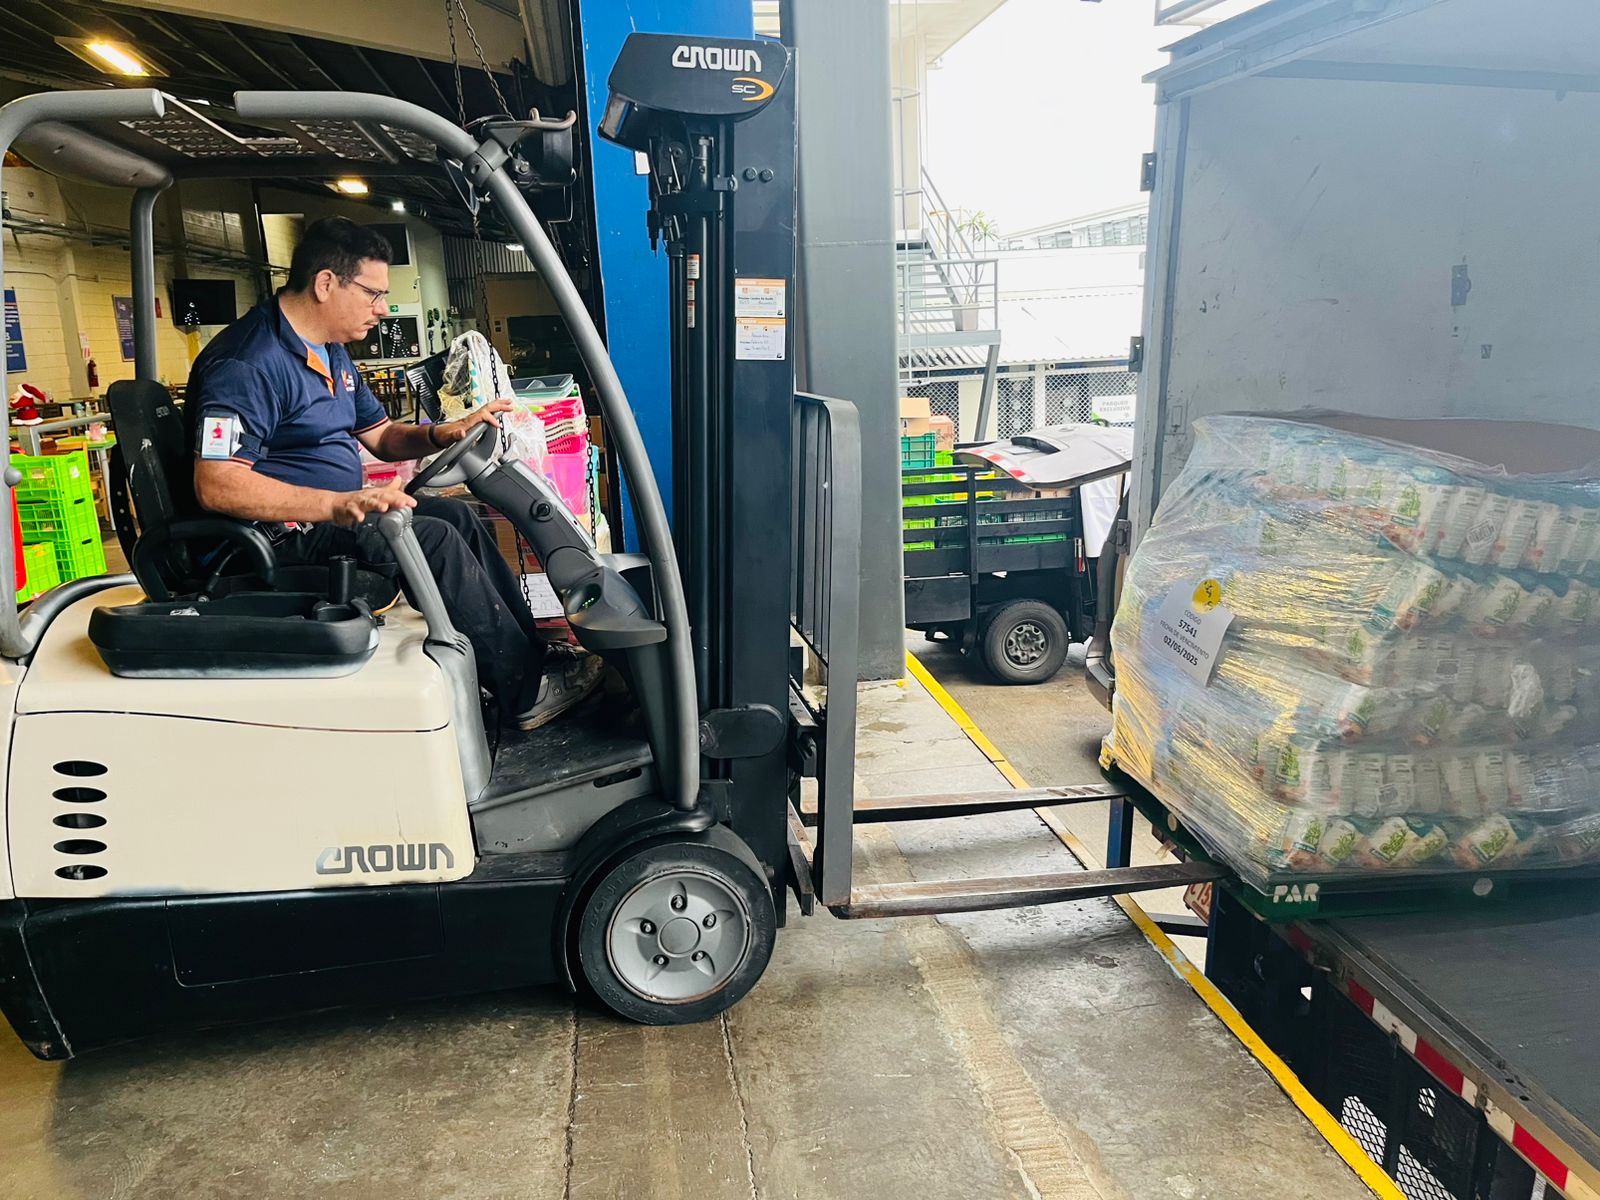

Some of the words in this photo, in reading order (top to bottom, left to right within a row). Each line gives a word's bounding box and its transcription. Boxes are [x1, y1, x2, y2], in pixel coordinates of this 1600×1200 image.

[672, 45, 762, 73] CROWN
[731, 84, 756, 94] SC
[1178, 620, 1197, 637] 57541
[1163, 635, 1198, 665] 02/05/2025
[315, 842, 454, 875] CROWN
[1273, 883, 1320, 903] PAR
